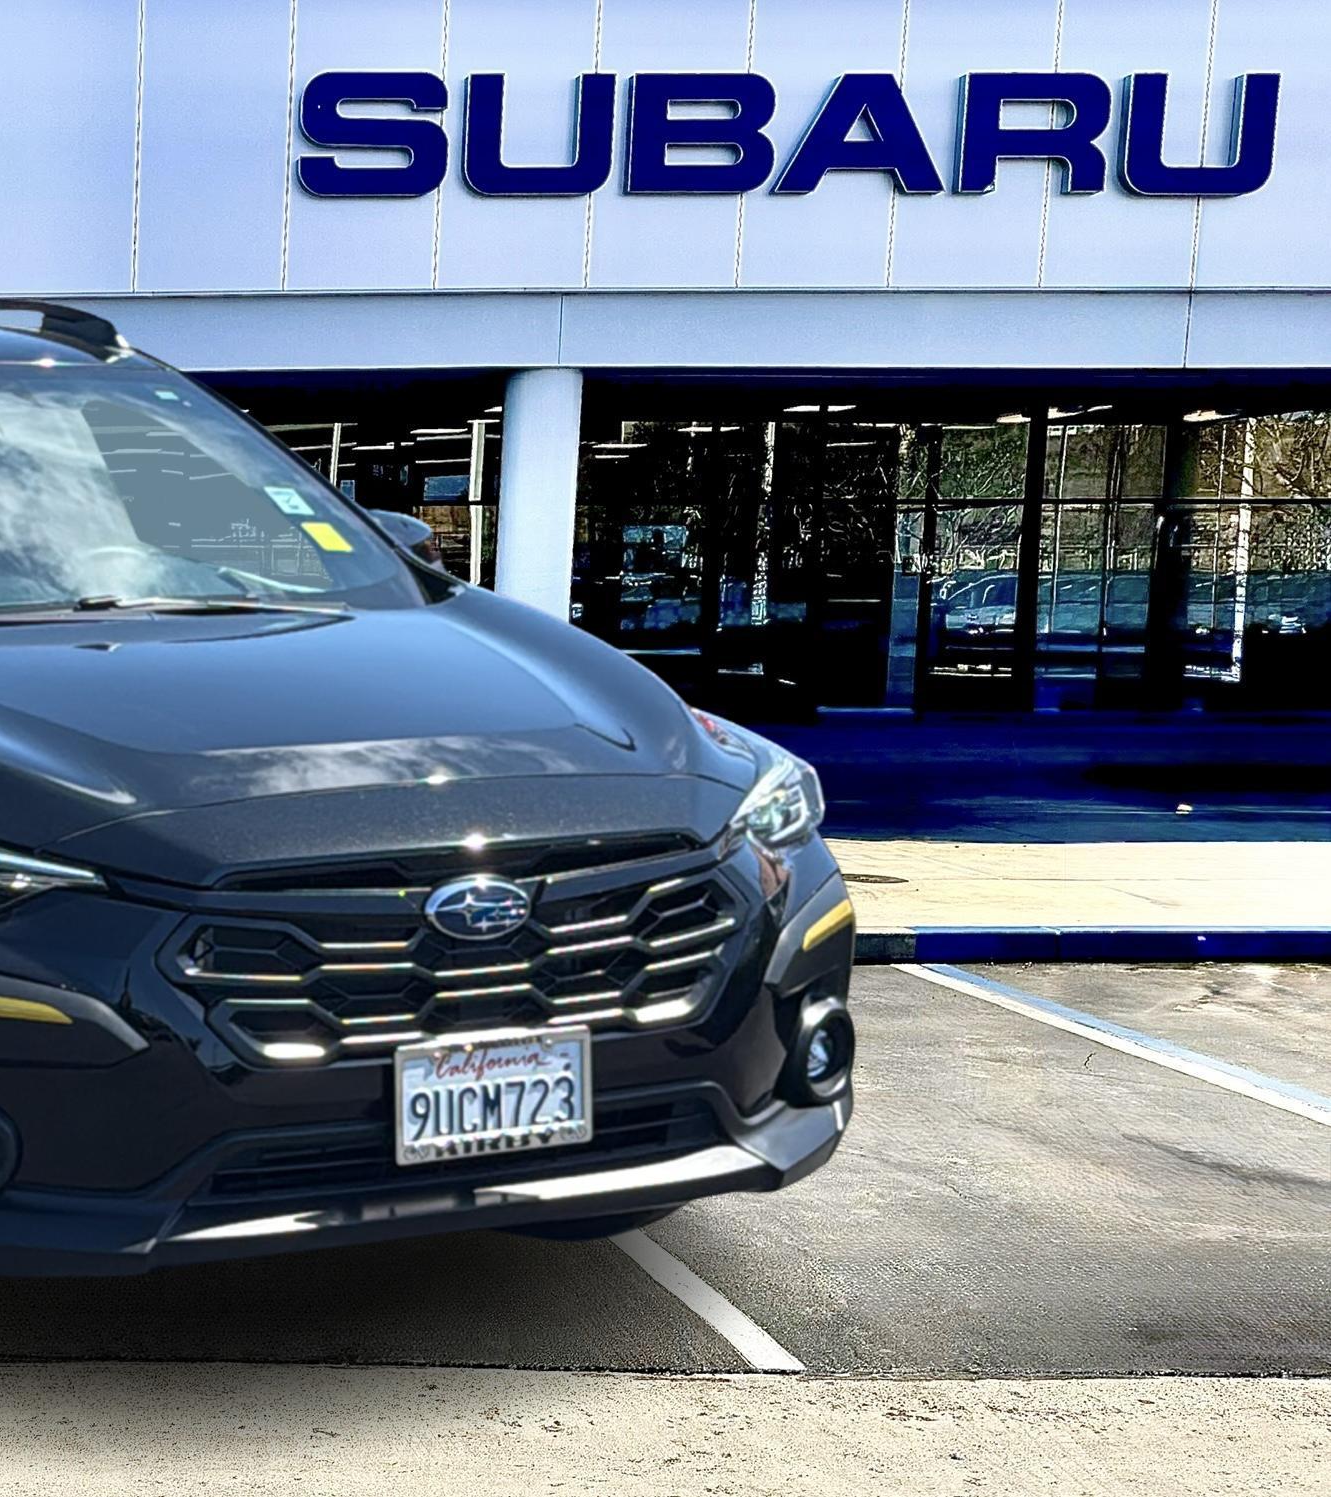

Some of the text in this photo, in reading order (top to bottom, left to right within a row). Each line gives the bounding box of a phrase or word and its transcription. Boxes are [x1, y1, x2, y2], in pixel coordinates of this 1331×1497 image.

[296, 70, 1281, 198] SUBARU
[433, 1050, 550, 1081] California
[409, 1076, 575, 1142] 9UCM723
